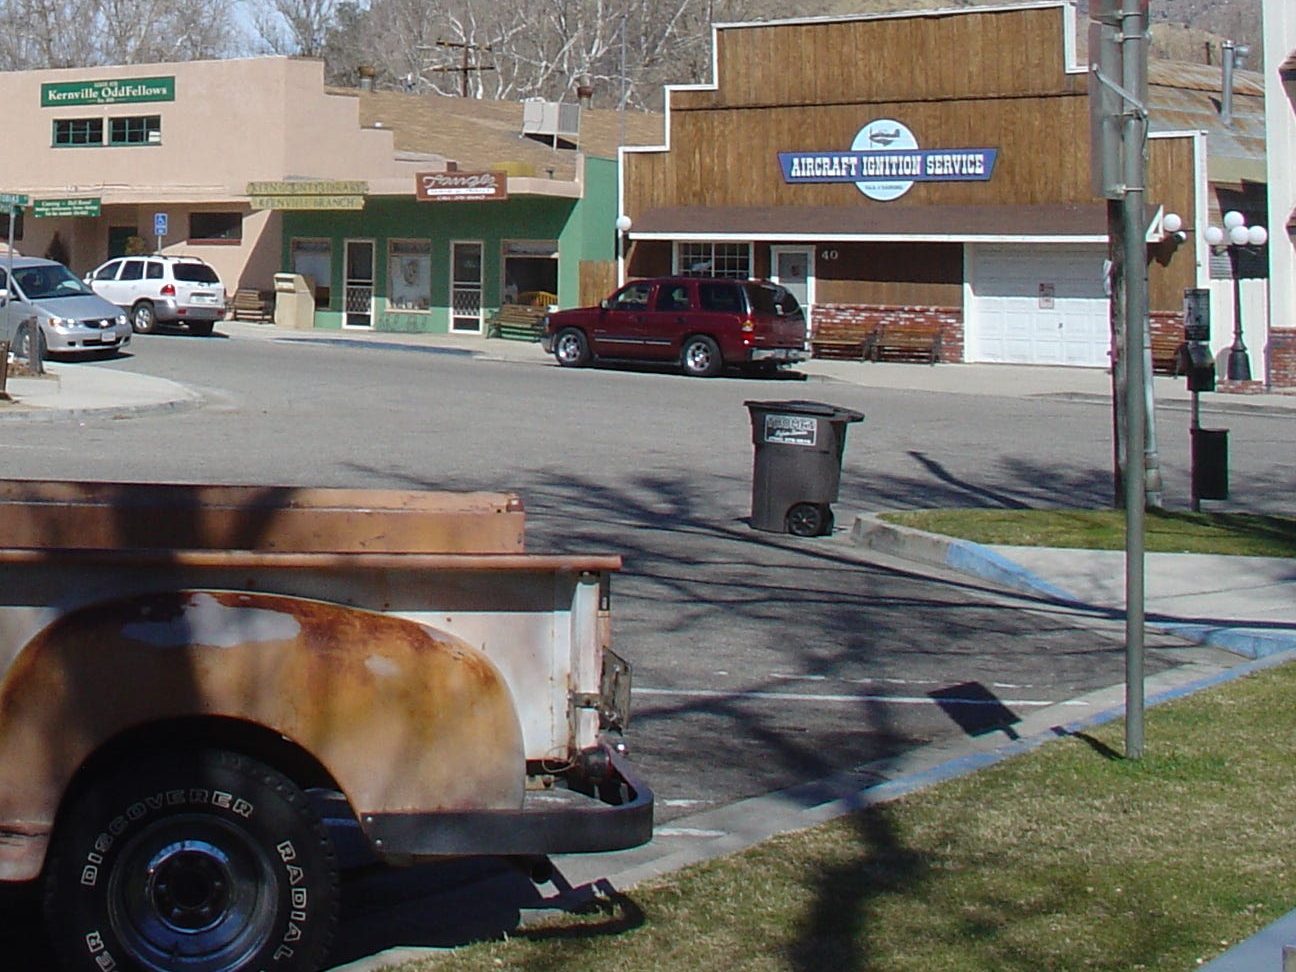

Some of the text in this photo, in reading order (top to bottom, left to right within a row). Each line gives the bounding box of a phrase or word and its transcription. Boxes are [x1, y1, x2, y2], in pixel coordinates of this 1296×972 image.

[47, 87, 98, 101] Kernville
[101, 84, 167, 98] OddFellows
[790, 154, 984, 177] AIRCRAFT IGNITION SERVICE
[821, 250, 838, 260] 40
[81, 788, 253, 886] DISCOVERER
[273, 840, 307, 960] RADIAL
